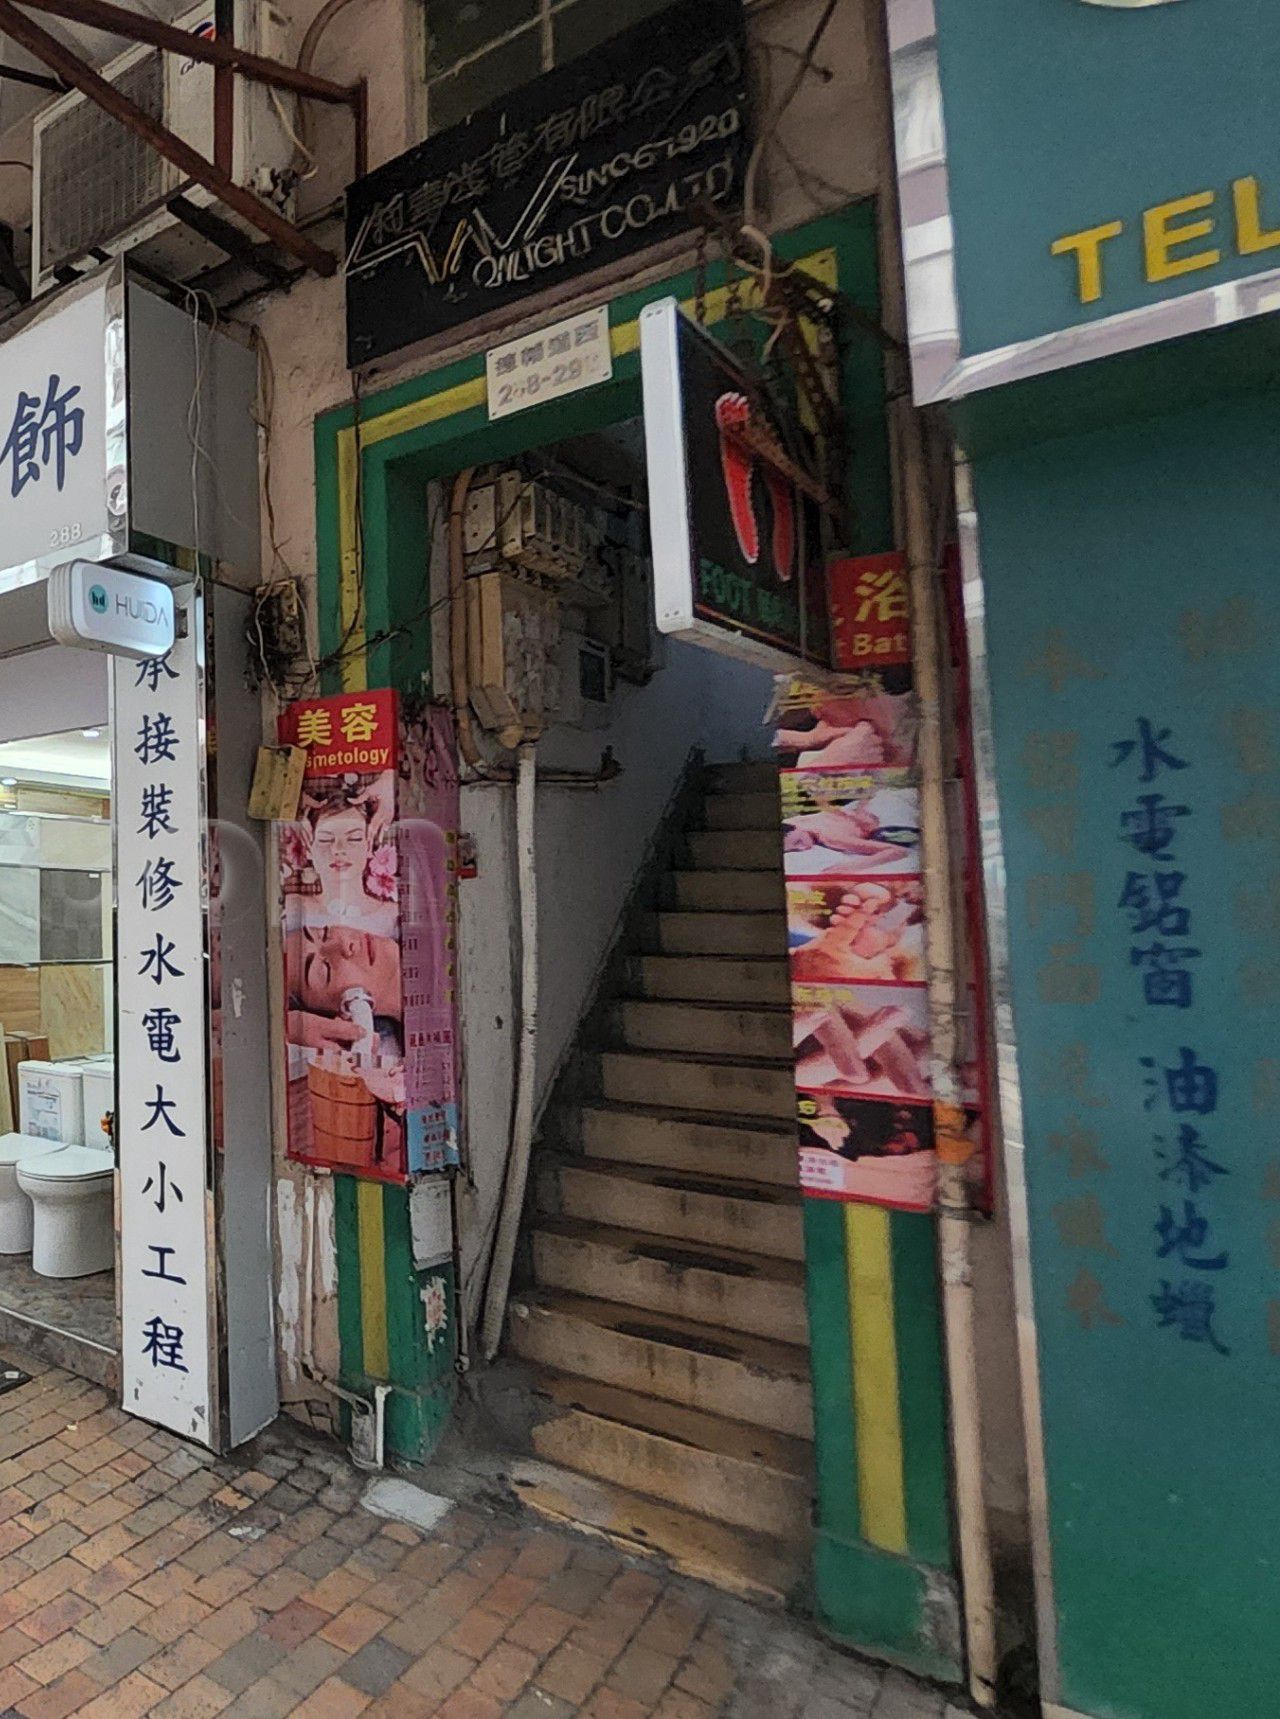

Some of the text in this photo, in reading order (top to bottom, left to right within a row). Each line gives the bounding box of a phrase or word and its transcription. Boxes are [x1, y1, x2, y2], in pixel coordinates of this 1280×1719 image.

[49, 522, 82, 548] 288
[852, 632, 908, 656] Bat
[297, 702, 380, 748] 美容
[133, 648, 190, 1374] 承接裝修水電大小工程
